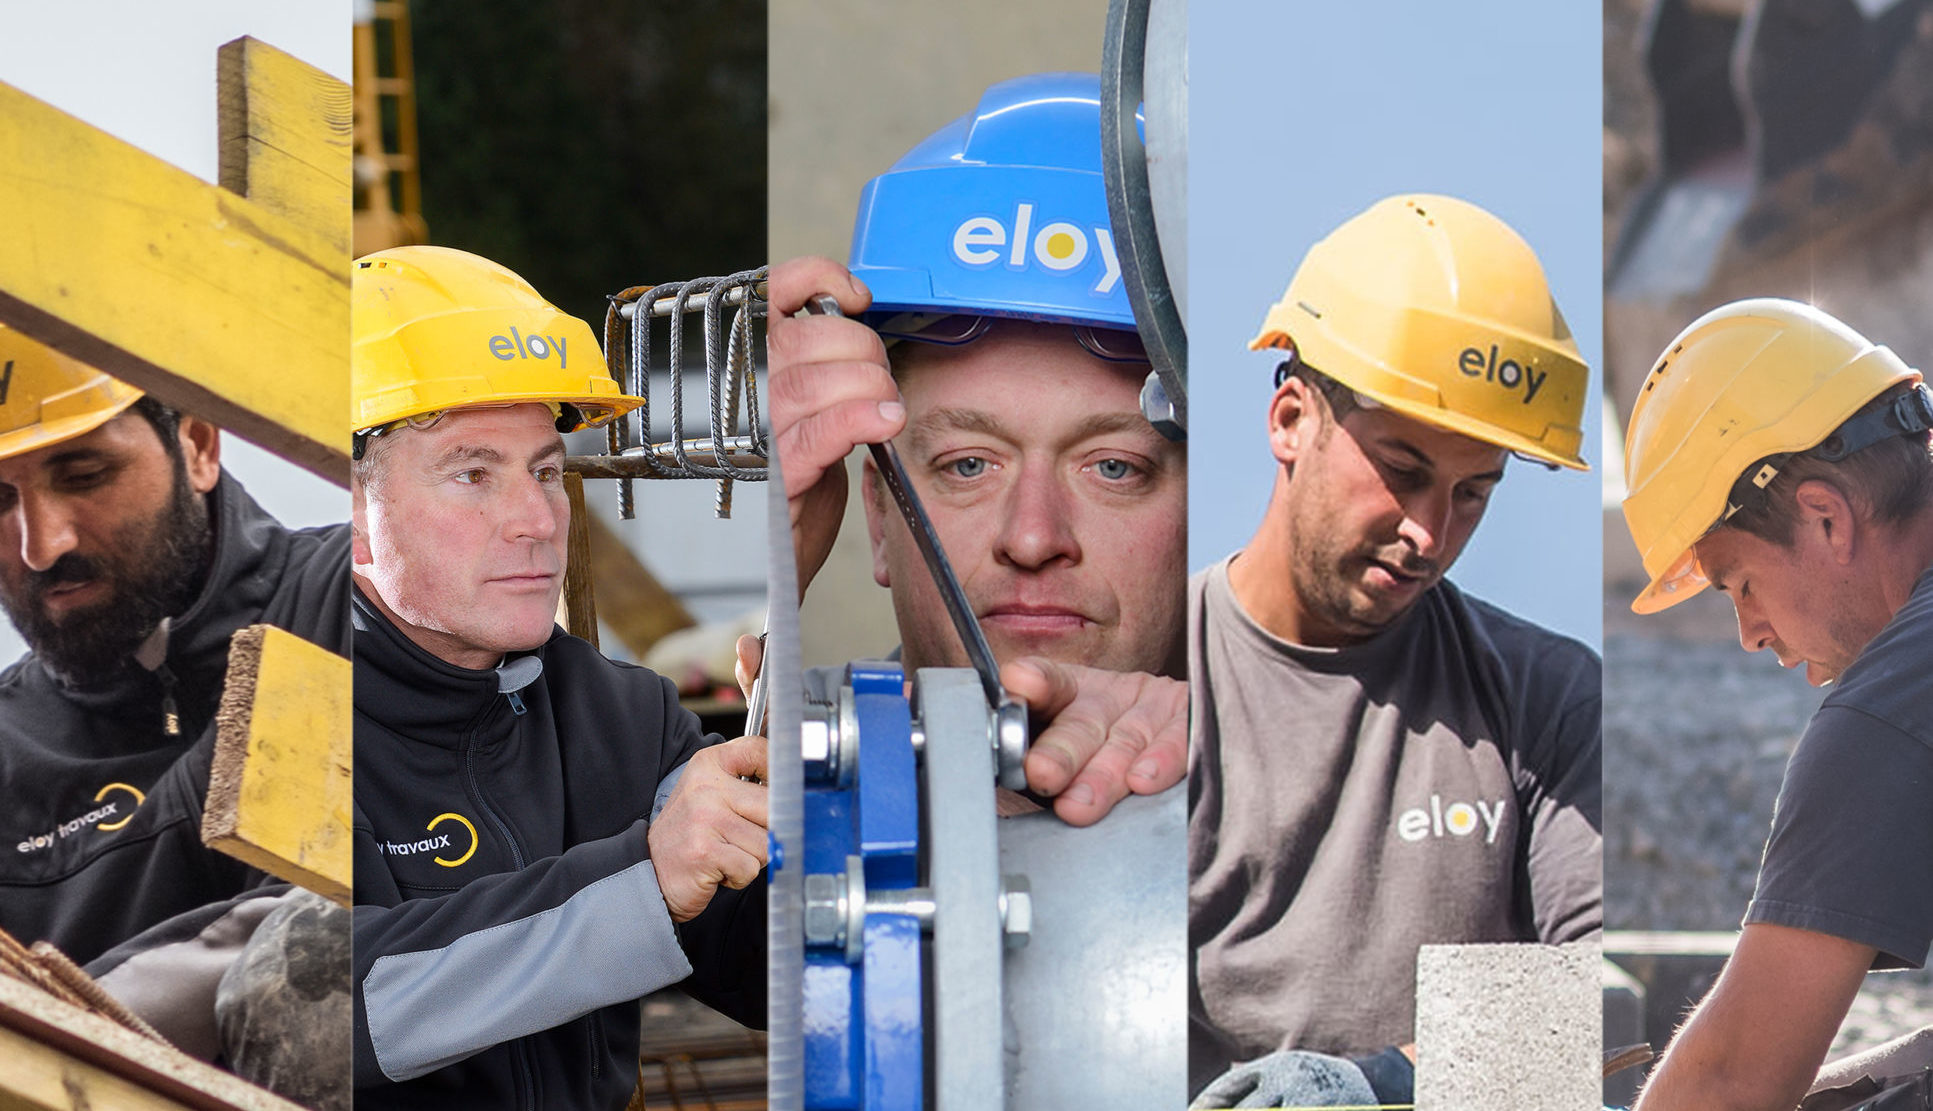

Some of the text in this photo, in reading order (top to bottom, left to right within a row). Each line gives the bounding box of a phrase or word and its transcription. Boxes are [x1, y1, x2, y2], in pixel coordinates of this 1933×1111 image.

[953, 203, 1122, 293] eloy
[488, 326, 567, 370] eloy
[1458, 344, 1547, 404] eloy
[16, 802, 118, 853] eloy travaux
[1397, 794, 1506, 844] eloy
[386, 833, 451, 856] travaux
